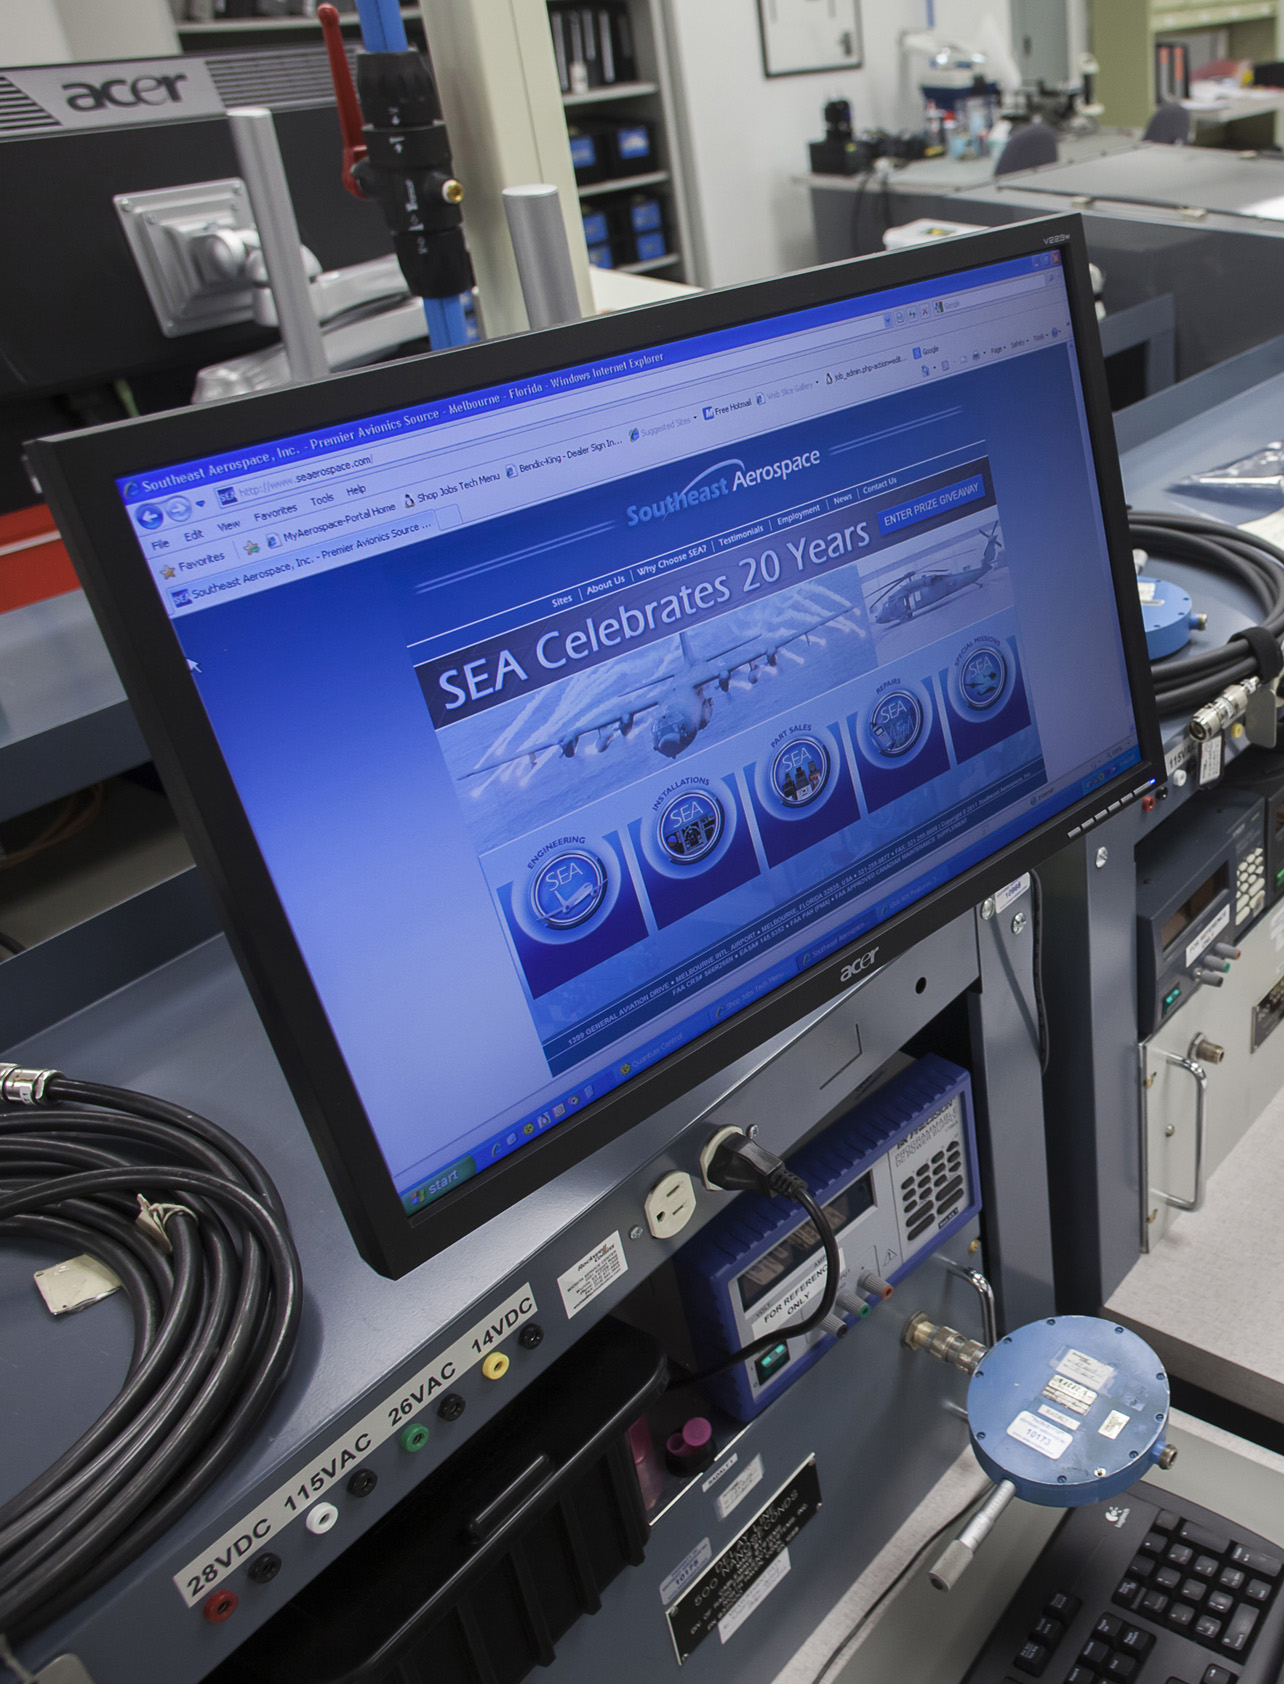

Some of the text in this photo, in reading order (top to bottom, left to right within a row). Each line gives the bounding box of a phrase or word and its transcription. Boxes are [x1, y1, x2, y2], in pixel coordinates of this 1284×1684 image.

[61, 72, 187, 112] acer
[142, 352, 664, 492] Southeast Aerospace, Inc. Premier Avionics Source Melbourne Florida Windows Internet Explorer
[179, 552, 225, 572] Favorites
[283, 508, 371, 542] MyAerospace-Portal
[371, 502, 396, 518] Home
[418, 489, 438, 503] Shop
[440, 484, 457, 497] Jobs
[459, 478, 478, 491] Tech
[479, 472, 500, 485] Menu
[519, 454, 562, 473] Bendix-King
[567, 445, 589, 459] Dealer
[591, 441, 606, 453] Sign
[641, 420, 674, 438] Suggested
[676, 416, 691, 427] Sites
[715, 405, 729, 416] Free
[730, 398, 752, 412] Hotmail
[626, 450, 820, 527] Southeast Aerospace
[884, 483, 979, 526] ENTER PRIZE GIVEAWAY
[152, 484, 366, 551] File Edit View Favorites Tools Help
[192, 577, 241, 600] Southeast
[243, 563, 295, 583] Aerospace,
[296, 555, 314, 568] Inc.
[322, 542, 354, 559] Premier
[356, 532, 390, 549] Avionics
[391, 522, 419, 538] Source
[552, 476, 897, 608] Sites About Us Why Choose SEA? Testimonials Employment News Contact Us
[439, 522, 870, 710] SEA Celebrates 20 Years
[954, 635, 1000, 666] SPECIAL MISSIONS
[968, 656, 992, 677] SEA
[876, 678, 901, 694] REPAIRS
[881, 701, 906, 724] SEA
[771, 724, 811, 748] PART SALES
[782, 748, 811, 772] SEA
[652, 777, 710, 811] INSTALLATIONS
[670, 801, 703, 828] SEA
[527, 836, 585, 870] ENGINEERING
[545, 863, 583, 891] SEA
[568, 1032, 584, 1045] 1399
[586, 1013, 618, 1036] GENERAL
[618, 995, 649, 1016] AVIATION
[650, 983, 669, 998] DRIVE
[675, 956, 714, 983] MELBOURNE
[731, 932, 756, 950] AIRPORT
[799, 894, 823, 911] FLORIDA
[840, 947, 879, 982] acer
[429, 1169, 459, 1194] start
[764, 1305, 782, 1323] FOR
[784, 1264, 829, 1305] REFERENC
[787, 1292, 810, 1315] ONLY
[186, 1296, 533, 1598] 28VDC 115VAC 26VAC 14VDC
[694, 1578, 718, 1607] 500
[722, 1489, 799, 1577] NANOSECONDS
[715, 1535, 748, 1574] DELAY
[753, 1504, 776, 1532] LINE
